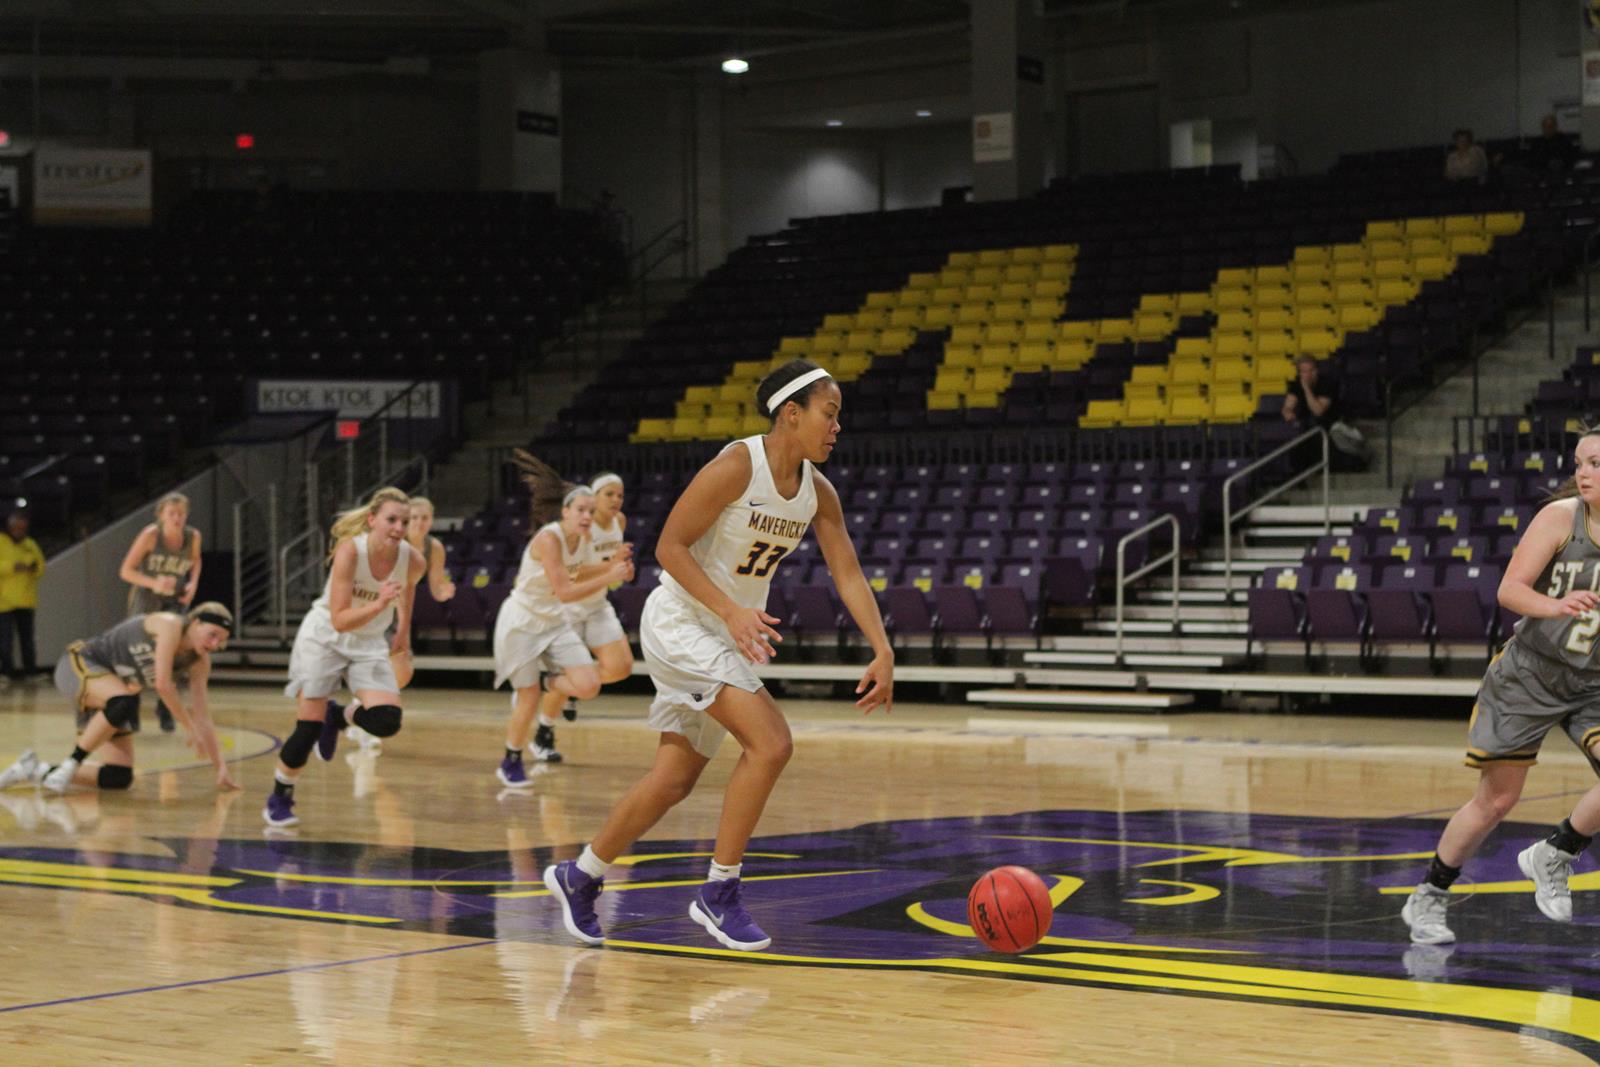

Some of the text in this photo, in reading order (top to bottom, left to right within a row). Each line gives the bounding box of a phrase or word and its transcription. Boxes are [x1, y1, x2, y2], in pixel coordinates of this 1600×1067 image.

[263, 386, 311, 406] KTOE
[324, 387, 372, 407] KTOE
[735, 540, 788, 577] 33
